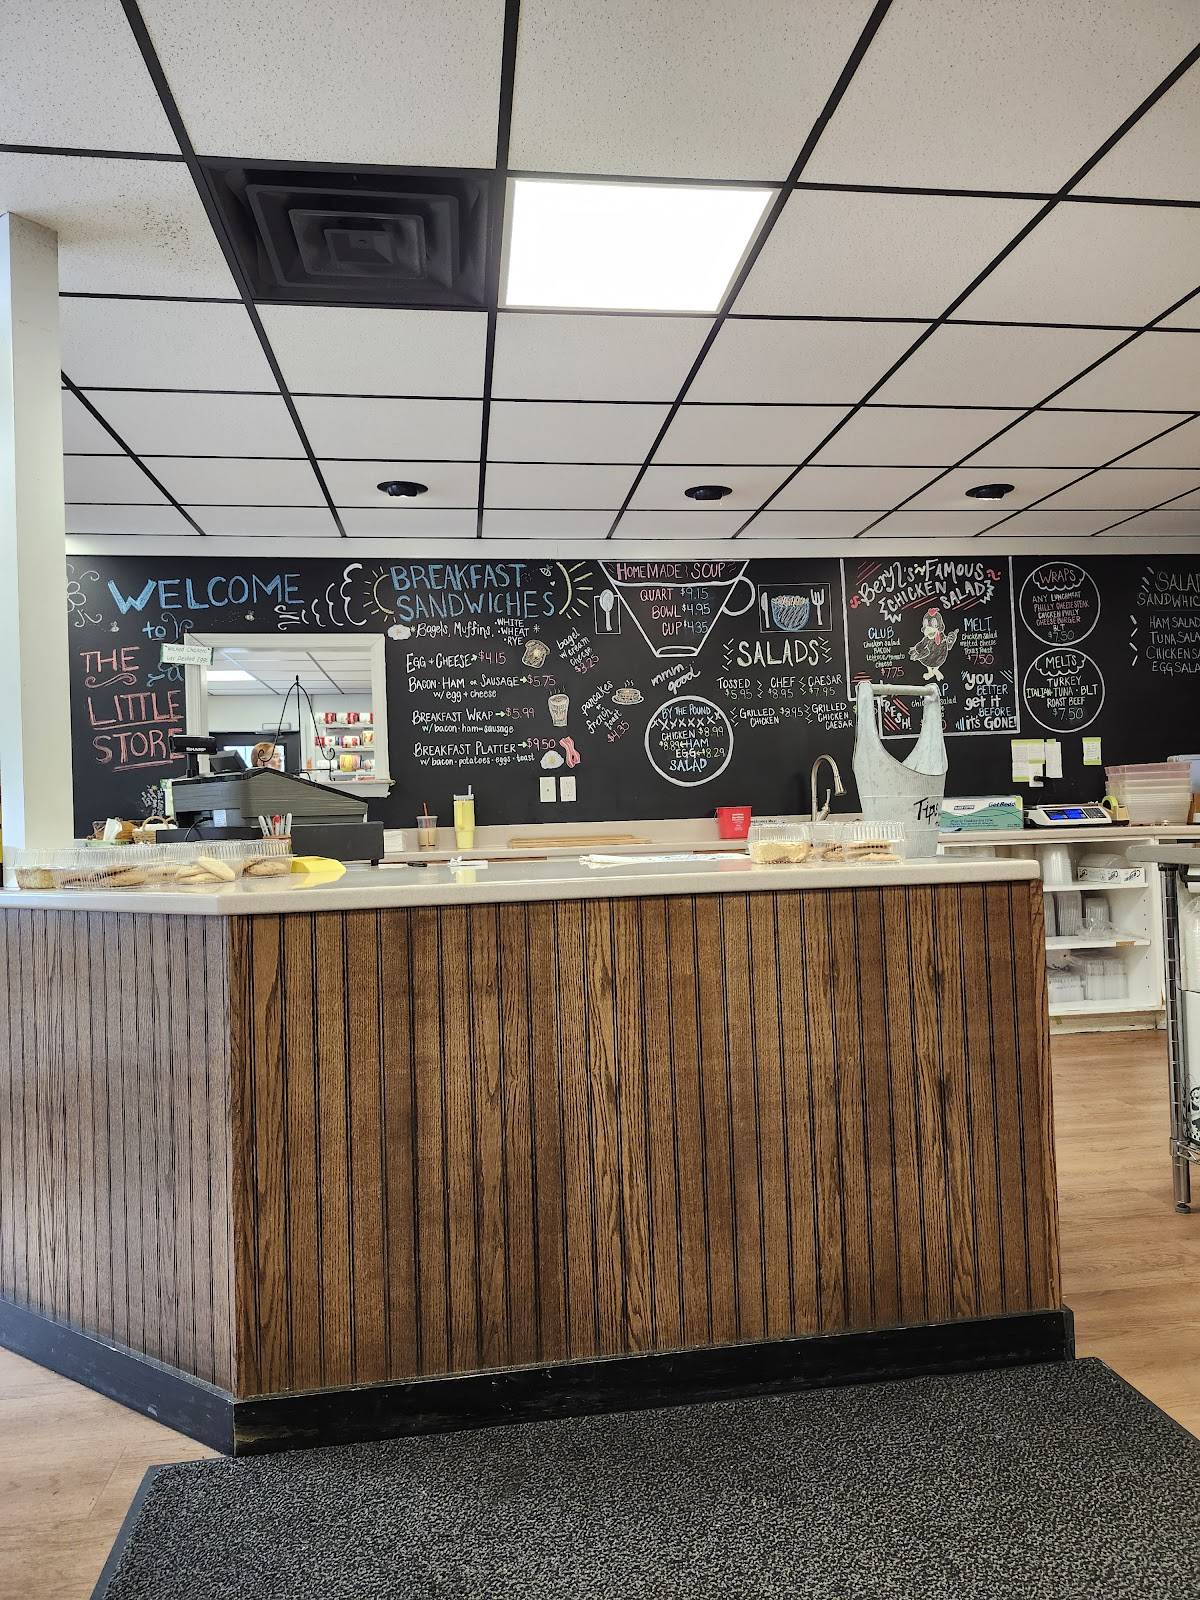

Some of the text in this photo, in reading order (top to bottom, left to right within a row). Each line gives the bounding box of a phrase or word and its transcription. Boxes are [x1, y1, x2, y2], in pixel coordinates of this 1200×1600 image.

[390, 564, 527, 591] BREAKFAST
[691, 563, 725, 579] SOUP
[1039, 568, 1076, 583] WRAPS
[858, 559, 984, 607] Beryl's FAMOUS
[107, 573, 305, 614] WELCOME
[640, 588, 674, 601] QUART
[887, 581, 947, 612] CHICKEN
[940, 581, 986, 610] SALAD
[1033, 594, 1048, 603] ANY
[396, 591, 555, 622] SANDWICHES
[652, 603, 711, 619] BOWL $4.95
[142, 621, 167, 638] to
[497, 617, 524, 628] WHITE
[662, 622, 682, 636] CUP
[964, 616, 992, 631] MELT
[1149, 616, 1170, 630] HAM
[501, 627, 529, 637] WHEAT
[556, 626, 580, 650] bagel
[868, 626, 894, 640] CLUB
[1148, 632, 1176, 645] TUNA
[507, 637, 523, 646] RYE
[568, 637, 590, 656] cream
[737, 639, 819, 667] SALADS
[1146, 646, 1190, 659] CHICKEN
[80, 647, 140, 673] THE
[436, 653, 472, 668] CHEESE
[1046, 655, 1077, 669] MELTS
[1152, 661, 1173, 676] EGG
[408, 677, 437, 692] BACON
[442, 677, 465, 689] HAM
[480, 674, 520, 688] SAUSAGE
[668, 667, 701, 695] good
[716, 677, 750, 689] TOSSED
[771, 676, 796, 688] CHEF
[808, 674, 843, 687] CAESAR
[1047, 676, 1081, 687] TURKEY
[470, 689, 497, 698] cheese
[977, 684, 1008, 696] BETTER
[1053, 687, 1074, 698] TUNA
[1081, 684, 1098, 695] BLT
[581, 680, 614, 716] pancakes
[964, 695, 1001, 711] get it
[1047, 697, 1085, 708] ROAST BEEF
[87, 690, 185, 725] LITTLE
[661, 703, 711, 720] BY THE POUND
[740, 708, 775, 719] GRILLED
[811, 702, 847, 714] GRILLED
[979, 707, 1011, 717] BEFORE
[412, 707, 535, 725] BREAKFAST WRAP $5.99
[586, 707, 614, 734] french
[751, 716, 780, 727] CHICKEN
[818, 712, 849, 722] CHICKEN
[984, 716, 1017, 730] GONE!
[826, 719, 853, 730] CAESAR
[662, 729, 696, 741] CHICKEN
[92, 728, 186, 764] STORE
[413, 742, 471, 757] BREAKFAST
[475, 741, 517, 755] PLATTER
[686, 738, 709, 748] HAM
[458, 757, 491, 767] potatoes
[496, 756, 511, 766] eggs
[516, 753, 535, 762] toast
[675, 747, 697, 759] EGG
[669, 759, 708, 773] SALAD
